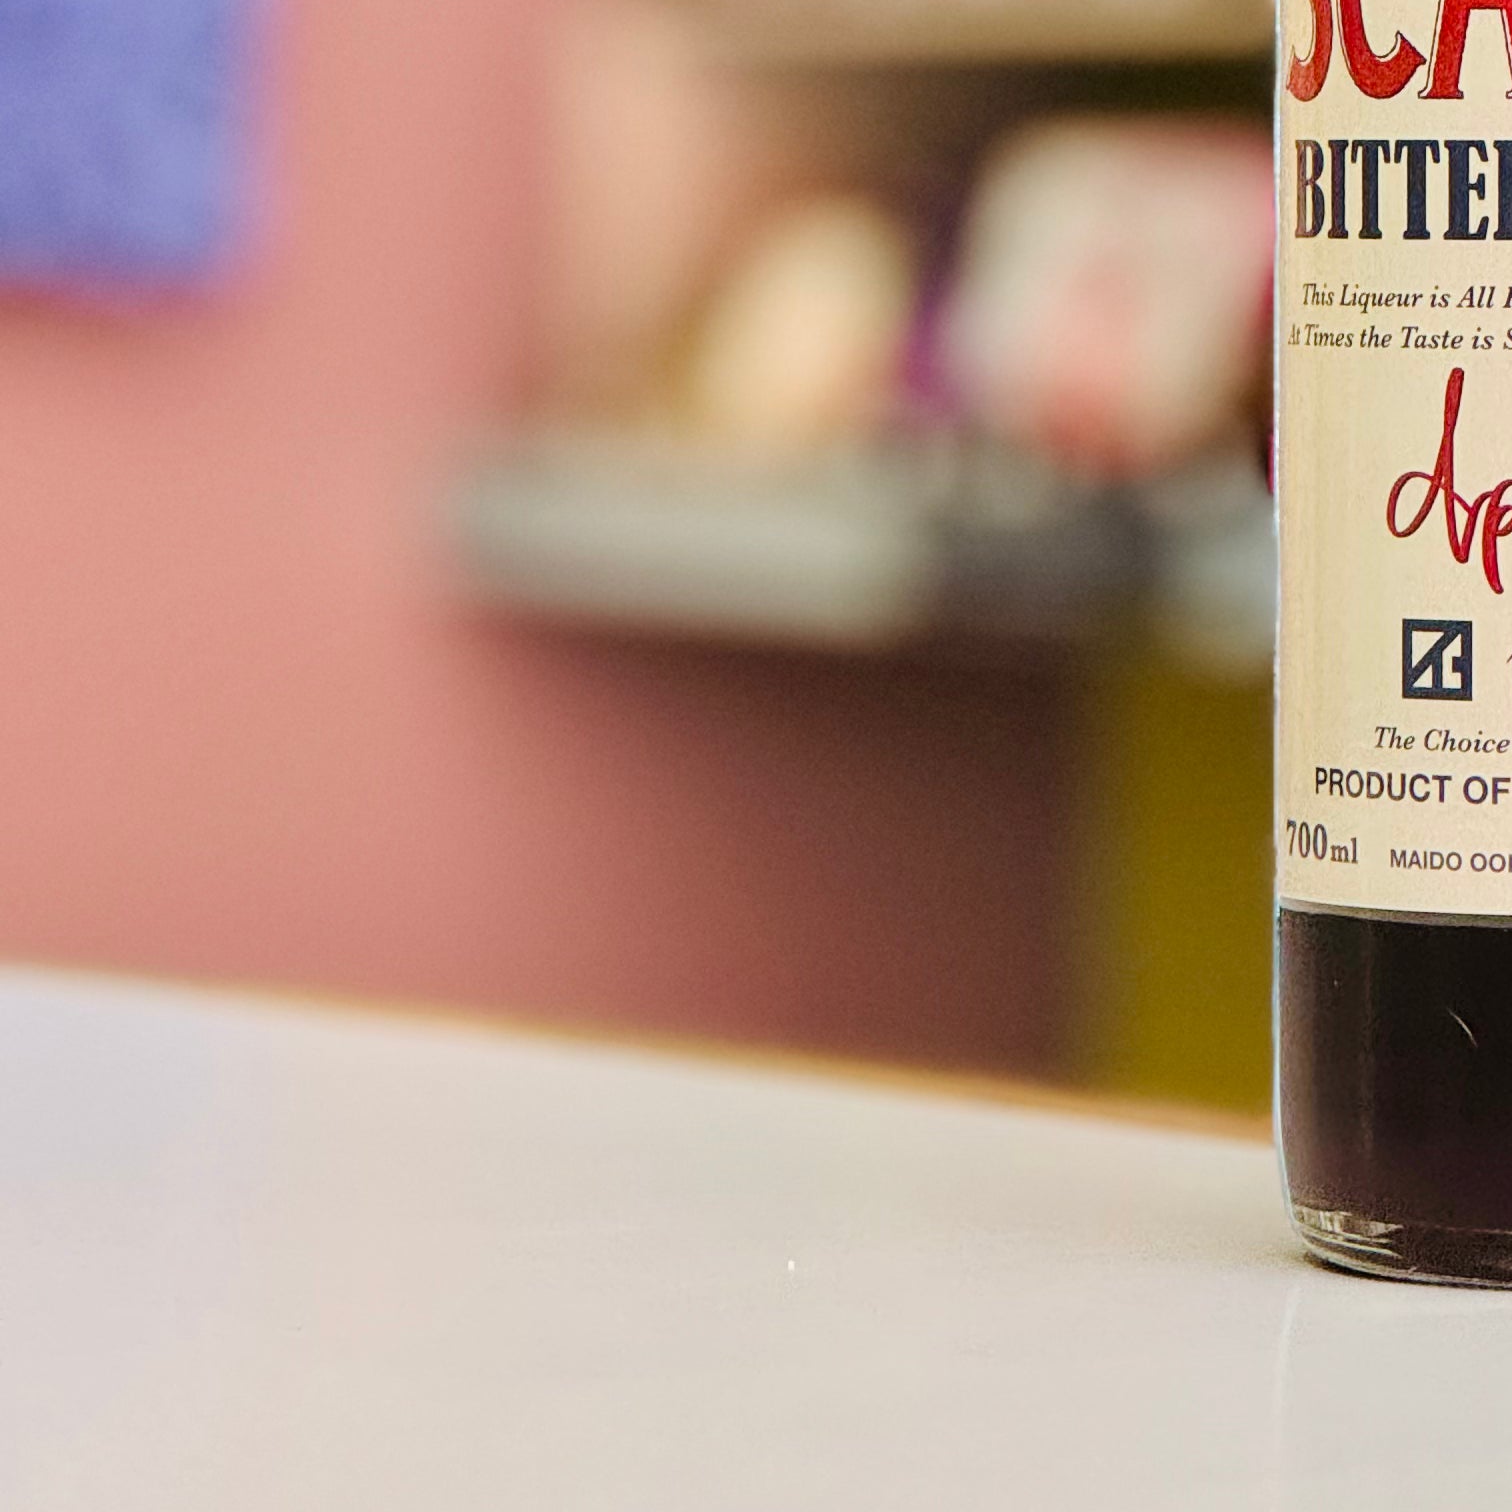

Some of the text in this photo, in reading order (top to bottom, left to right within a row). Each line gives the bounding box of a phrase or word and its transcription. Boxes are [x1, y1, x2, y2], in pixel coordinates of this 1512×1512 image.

[1302, 283, 1334, 308] This
[1339, 283, 1423, 314] Liqueur
[1429, 285, 1450, 309] is
[1456, 285, 1496, 309] All
[1288, 323, 1301, 345] At
[1304, 323, 1354, 348] Times
[1359, 325, 1392, 349] the
[1400, 325, 1462, 350] Taste
[1471, 326, 1494, 350] is
[1374, 726, 1415, 750] The
[1423, 728, 1510, 754] Choice
[1315, 767, 1452, 803] PRODUCT
[1463, 775, 1511, 805] OF
[1390, 848, 1462, 872] MAIDO
